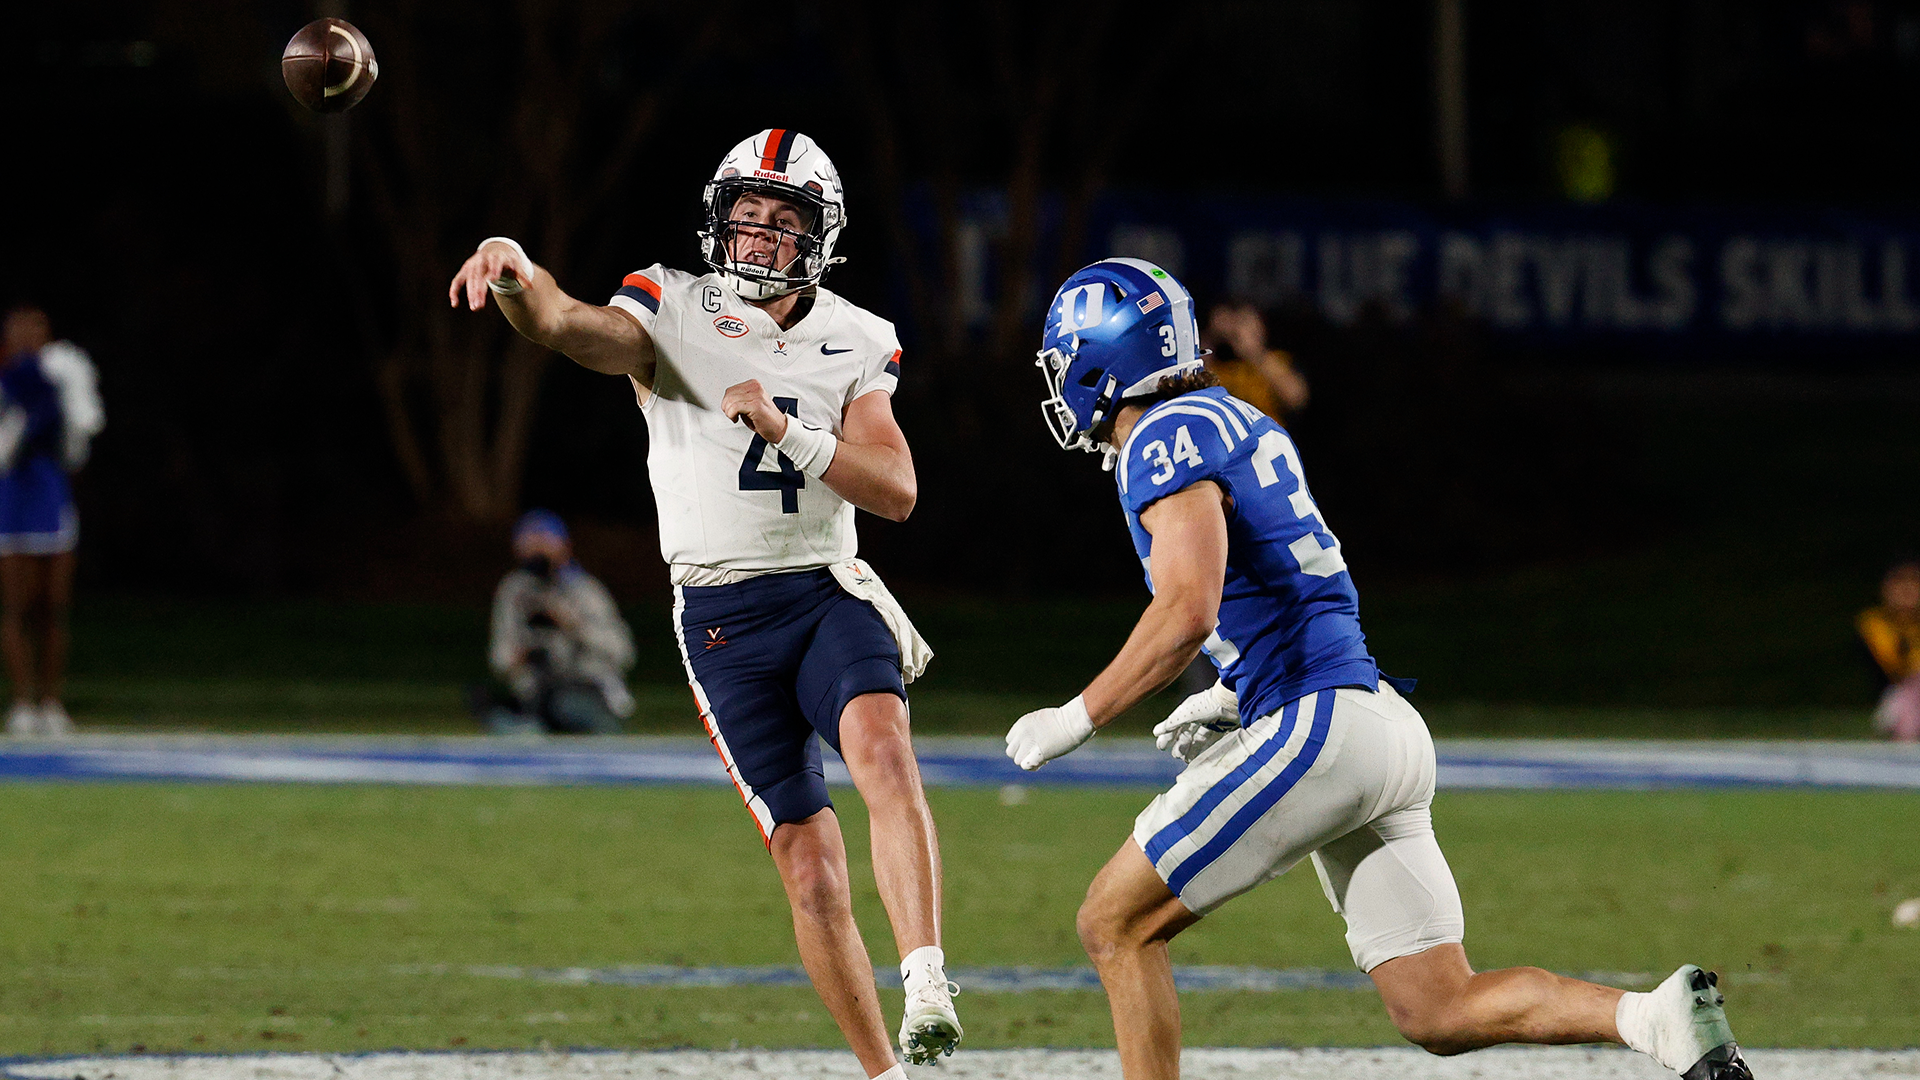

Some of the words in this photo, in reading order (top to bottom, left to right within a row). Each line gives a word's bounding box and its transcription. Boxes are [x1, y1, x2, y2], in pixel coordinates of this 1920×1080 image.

[753, 170, 789, 182] Riddell
[702, 286, 722, 313] C
[1438, 231, 1695, 327] DEVILS
[716, 320, 744, 332] ACC
[738, 397, 806, 514] 4
[1142, 424, 1204, 486] 34
